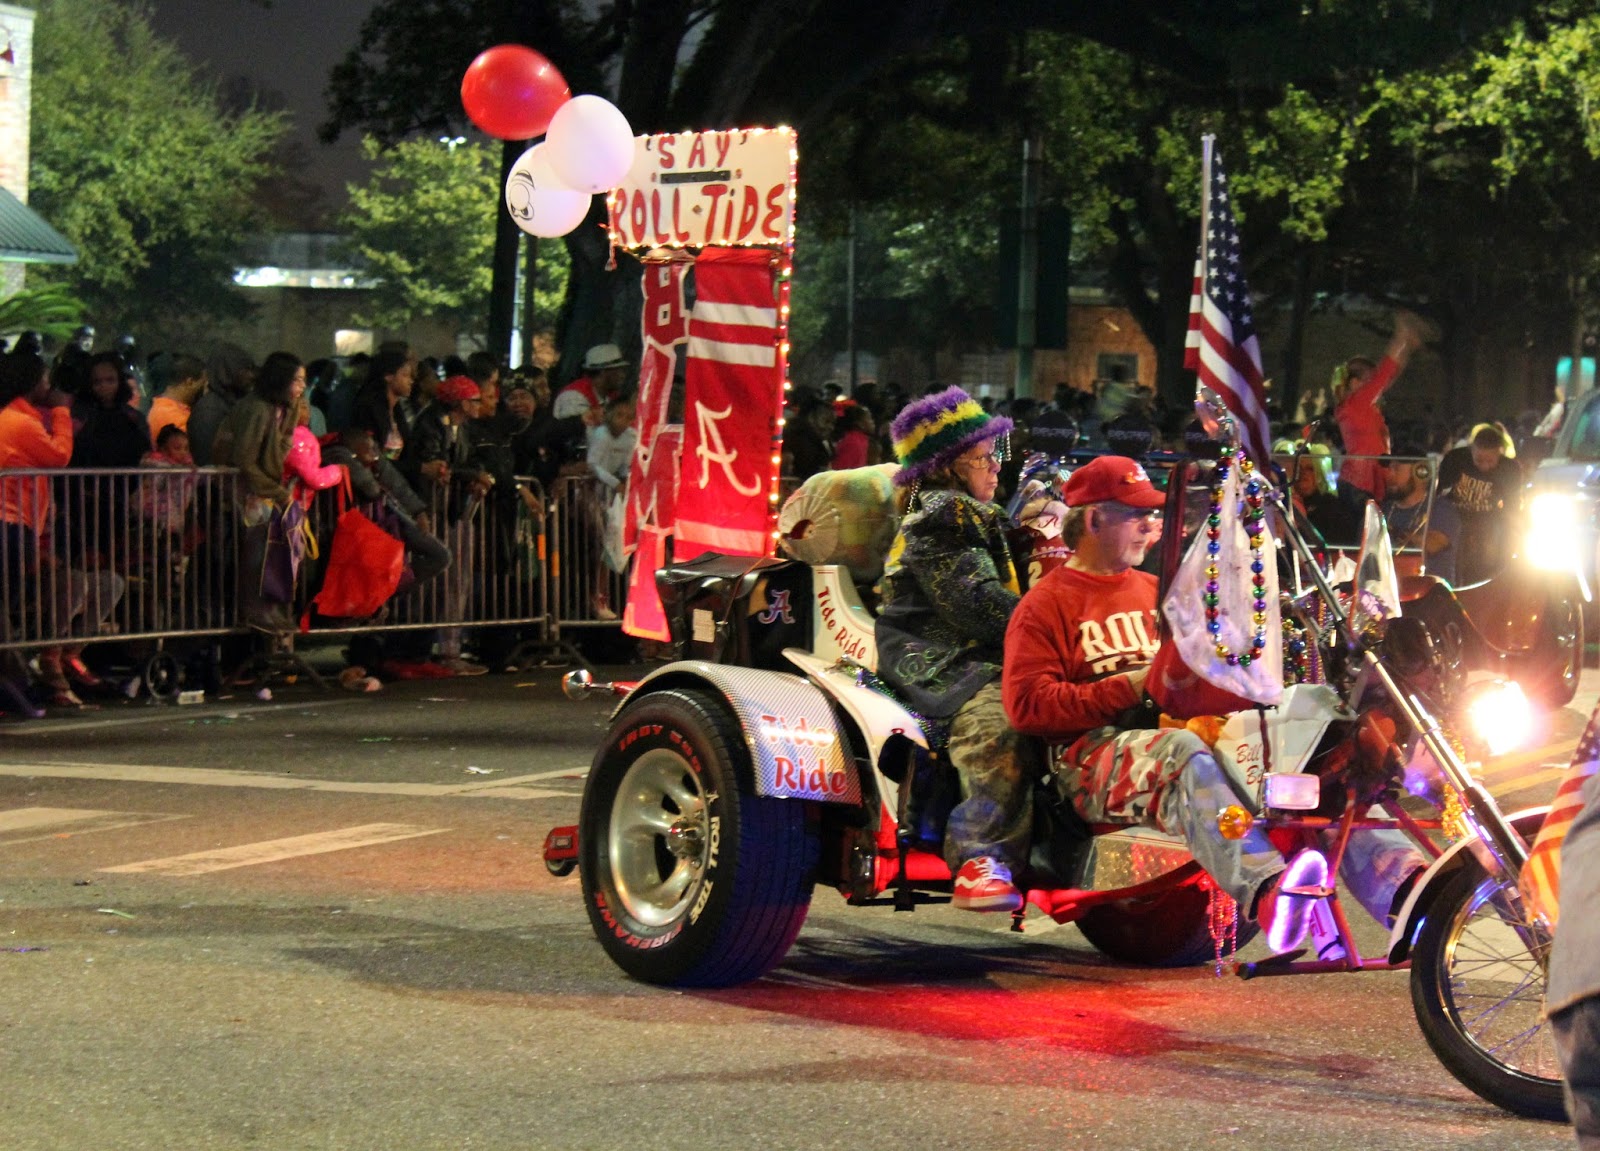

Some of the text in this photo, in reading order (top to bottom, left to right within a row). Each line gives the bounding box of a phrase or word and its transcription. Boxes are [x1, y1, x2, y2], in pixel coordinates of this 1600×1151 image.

[612, 187, 690, 244] ROLL
[695, 400, 761, 497] A
[758, 589, 796, 625] A
[817, 586, 866, 660] Tide Ride
[1079, 609, 1161, 662] ROL
[761, 714, 833, 748] Tide
[774, 757, 847, 795] Ride
[708, 816, 720, 869] ROLL
